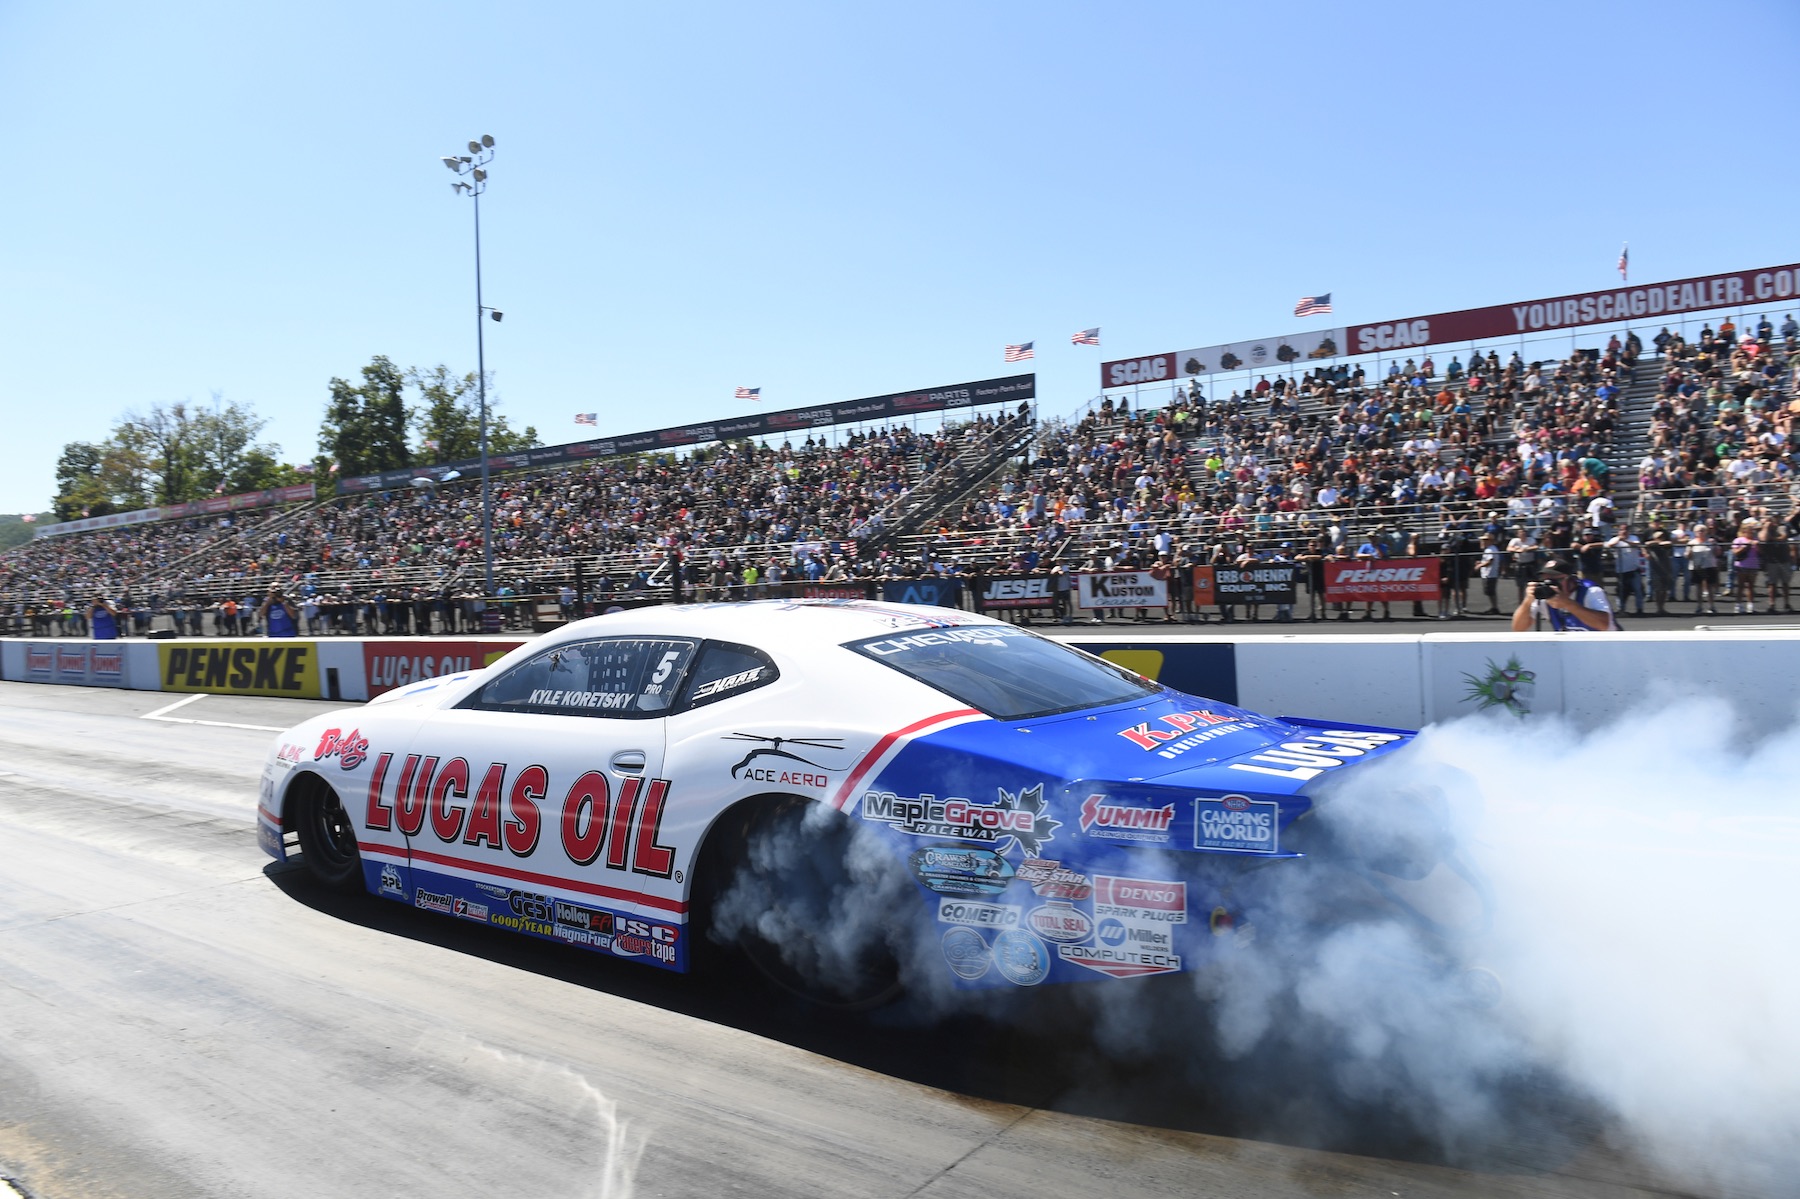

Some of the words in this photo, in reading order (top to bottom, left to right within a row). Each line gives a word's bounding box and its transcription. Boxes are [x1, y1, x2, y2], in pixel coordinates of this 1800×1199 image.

[1513, 269, 1800, 331] YOURSCAGDEALER.CO
[1359, 320, 1431, 353] SCAG
[1110, 356, 1168, 384] SCAG
[1216, 570, 1239, 583] ERB
[1253, 568, 1294, 583] HENRY
[1336, 567, 1427, 583] PENSKE
[983, 578, 1054, 600] JESEL
[1265, 583, 1291, 591] INC.
[1344, 585, 1379, 594] RACING
[1380, 584, 1418, 593] SHOCKS
[167, 647, 308, 690] PENSKE
[651, 651, 681, 684] 5
[528, 689, 562, 705] KYLE
[562, 691, 635, 708] KORETSKY
[644, 683, 663, 695] PRO
[1157, 724, 1246, 759] DEVELOPMENT
[1228, 730, 1402, 781] LUCAS
[743, 766, 776, 783] ACE
[779, 771, 828, 788] AERO
[365, 752, 549, 858] LUCAS
[560, 769, 677, 881] OIL
[1201, 809, 1270, 827] CAMPING
[1201, 822, 1271, 842] WORLD
[1016, 868, 1050, 880] RACE
[1050, 871, 1086, 884] STAR
[417, 888, 451, 906] Browell
[1039, 882, 1093, 900] PRO
[1120, 887, 1177, 904] DENSO
[556, 904, 590, 928] Holley
[941, 904, 1017, 925] COMETIC
[1034, 915, 1061, 930] TOTAL
[1063, 918, 1087, 932] SEAL
[1096, 905, 1138, 918] SPARK
[1142, 909, 1185, 922] PLUGS
[491, 913, 553, 936] GOODYEAR
[616, 916, 675, 942] ISC
[553, 924, 612, 948] MagnaFuel
[1128, 928, 1168, 944] Miller
[651, 939, 676, 963] tape
[1060, 945, 1180, 967] COMPUTECH
[1140, 944, 1169, 953] WELDERS
